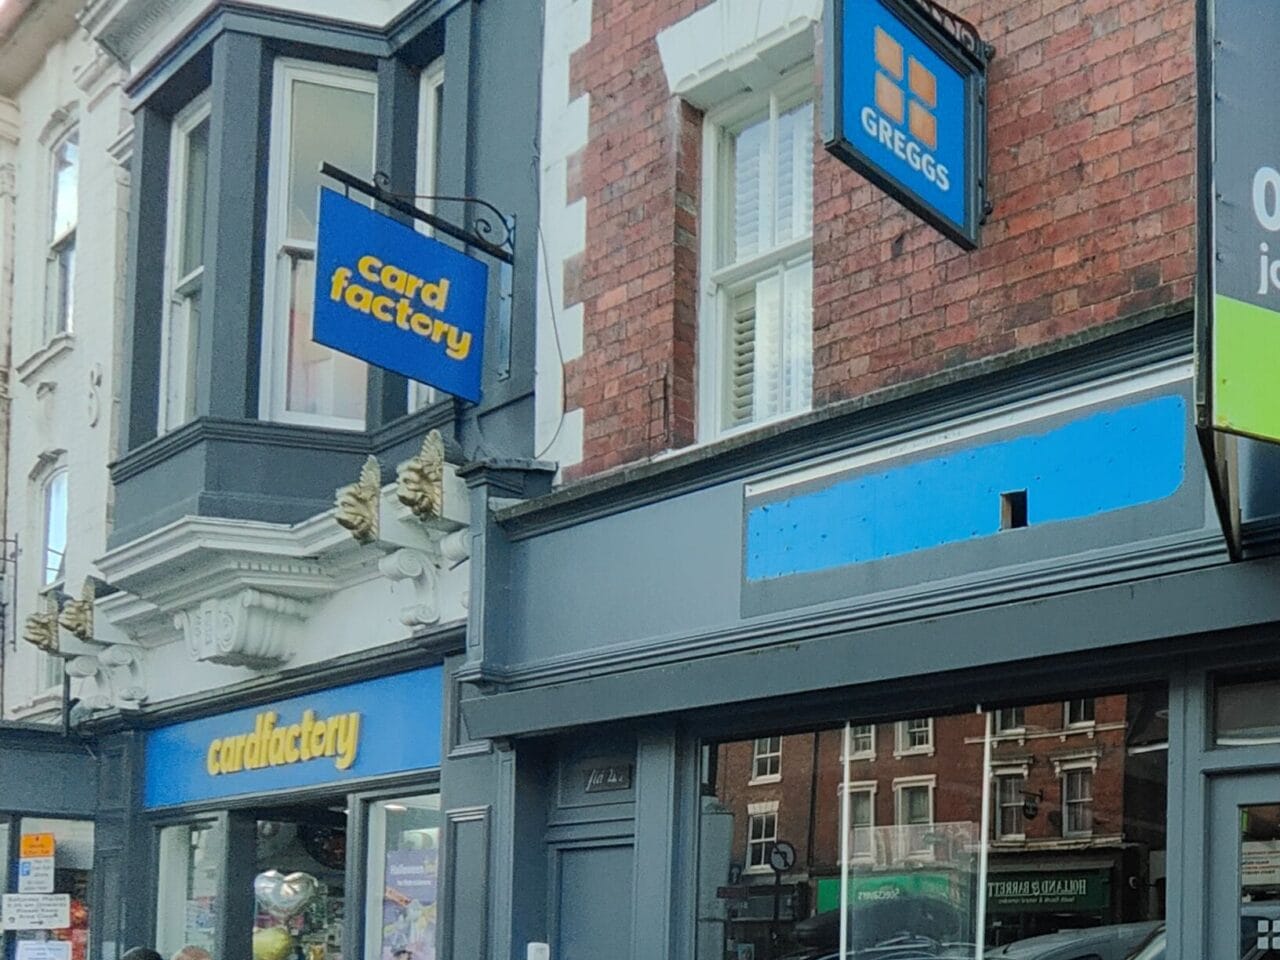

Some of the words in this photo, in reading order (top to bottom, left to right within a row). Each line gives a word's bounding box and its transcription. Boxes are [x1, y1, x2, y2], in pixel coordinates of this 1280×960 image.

[861, 106, 950, 192] GREGGS
[330, 266, 472, 360] factory
[358, 255, 449, 312] card
[207, 709, 360, 776] cardfactory
